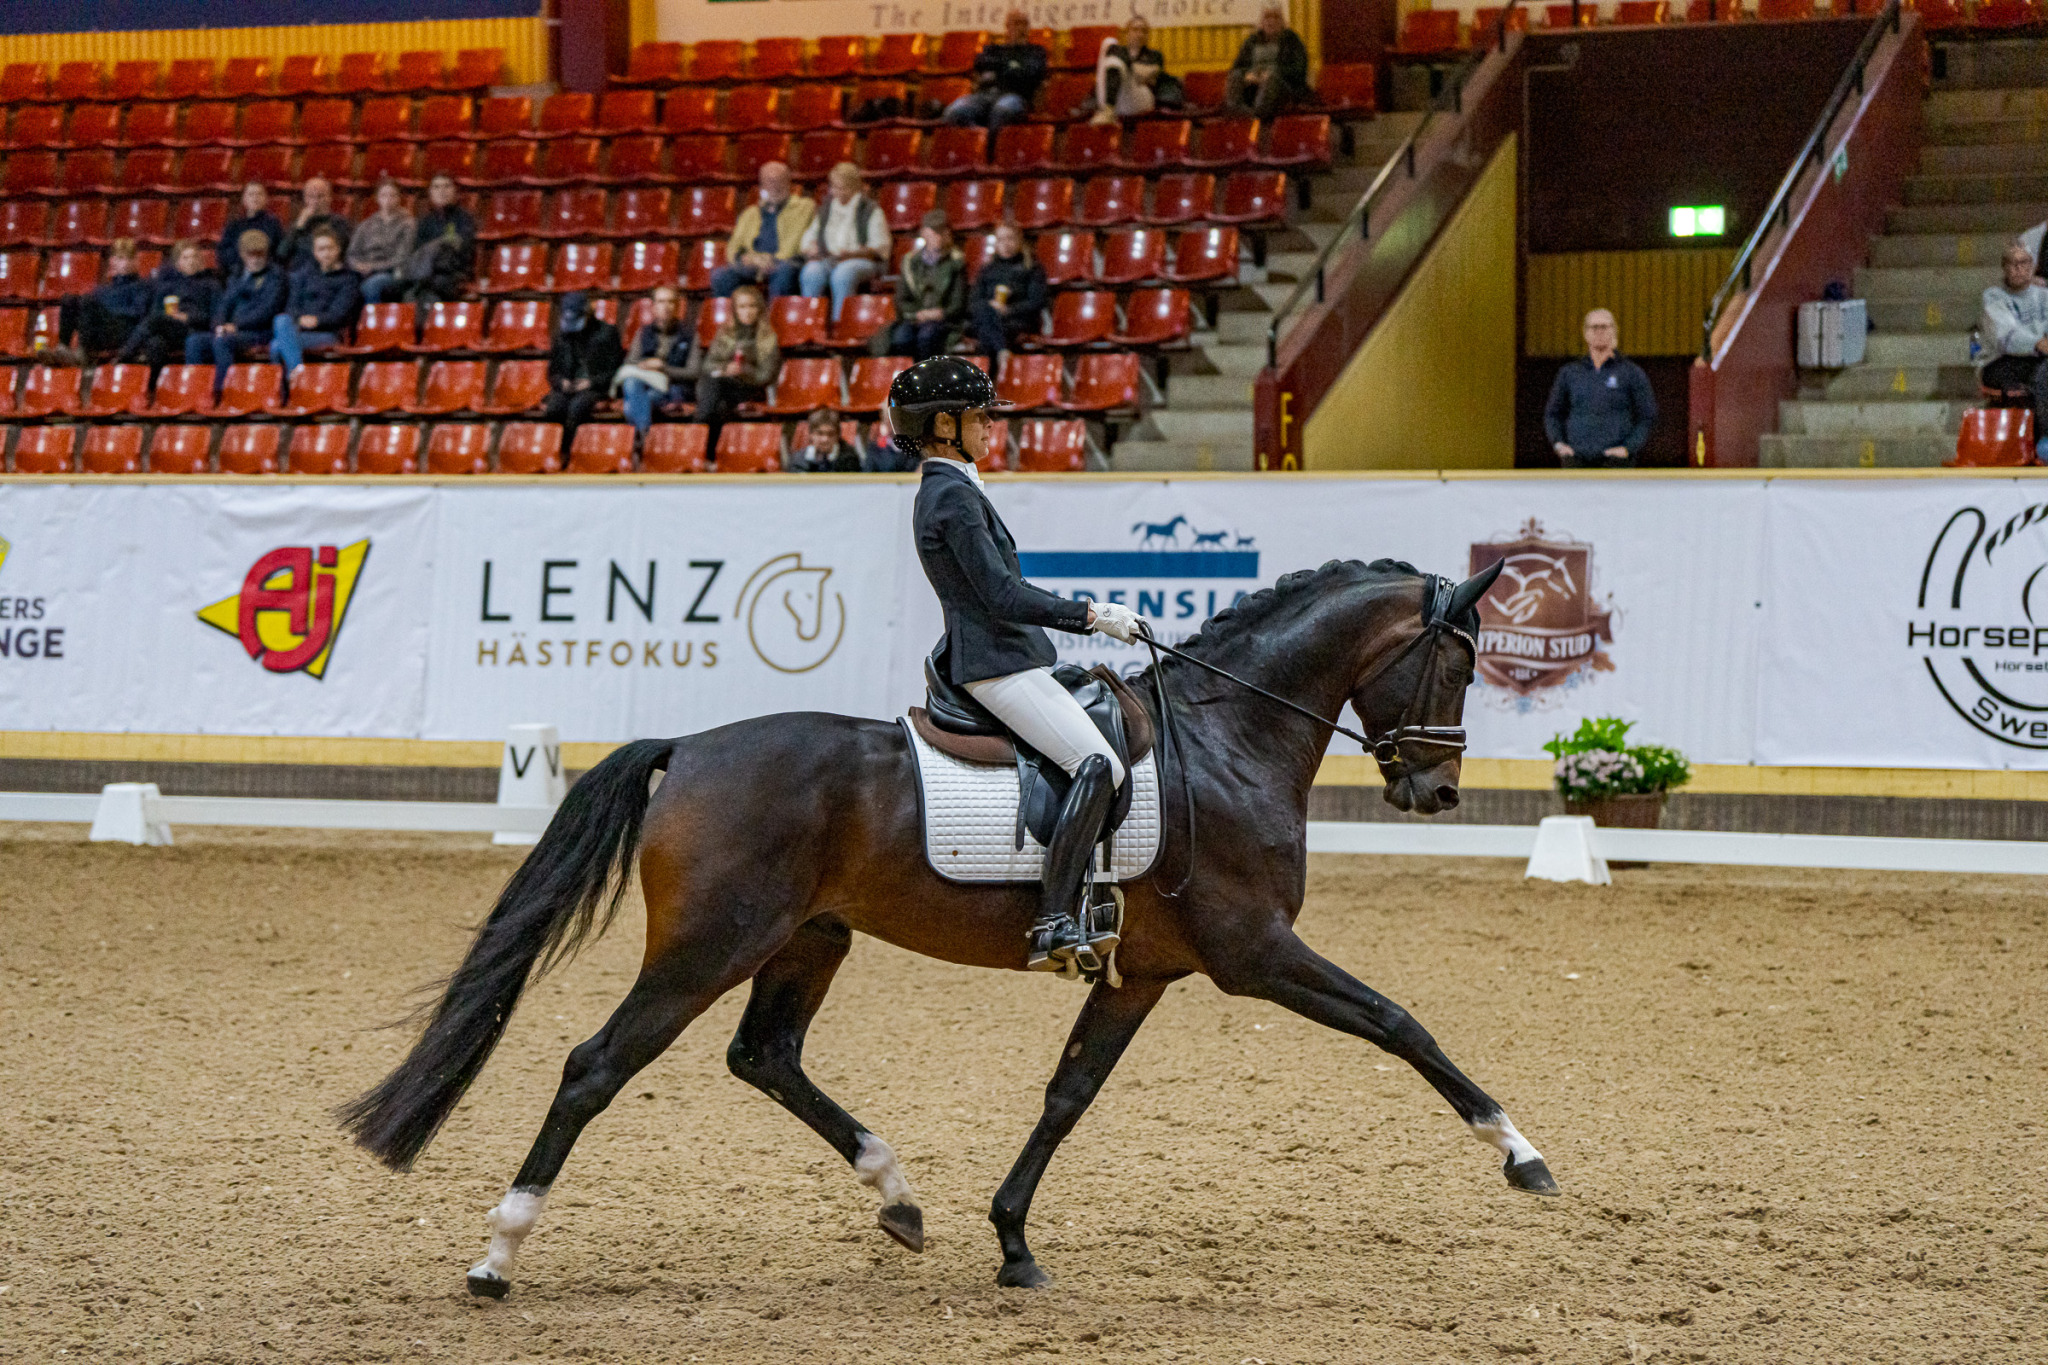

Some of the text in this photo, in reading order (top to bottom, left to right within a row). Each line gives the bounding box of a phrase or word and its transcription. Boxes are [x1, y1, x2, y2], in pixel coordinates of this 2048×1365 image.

[872, 5, 923, 28] The
[480, 560, 726, 623] LENZ
[477, 633, 719, 667] HÄSTFOKUS
[1549, 633, 1592, 658] STUD
[1908, 621, 2048, 656] Horsep
[1995, 660, 2048, 673] Horse
[1972, 697, 2048, 740] Swe
[510, 745, 536, 778] V
